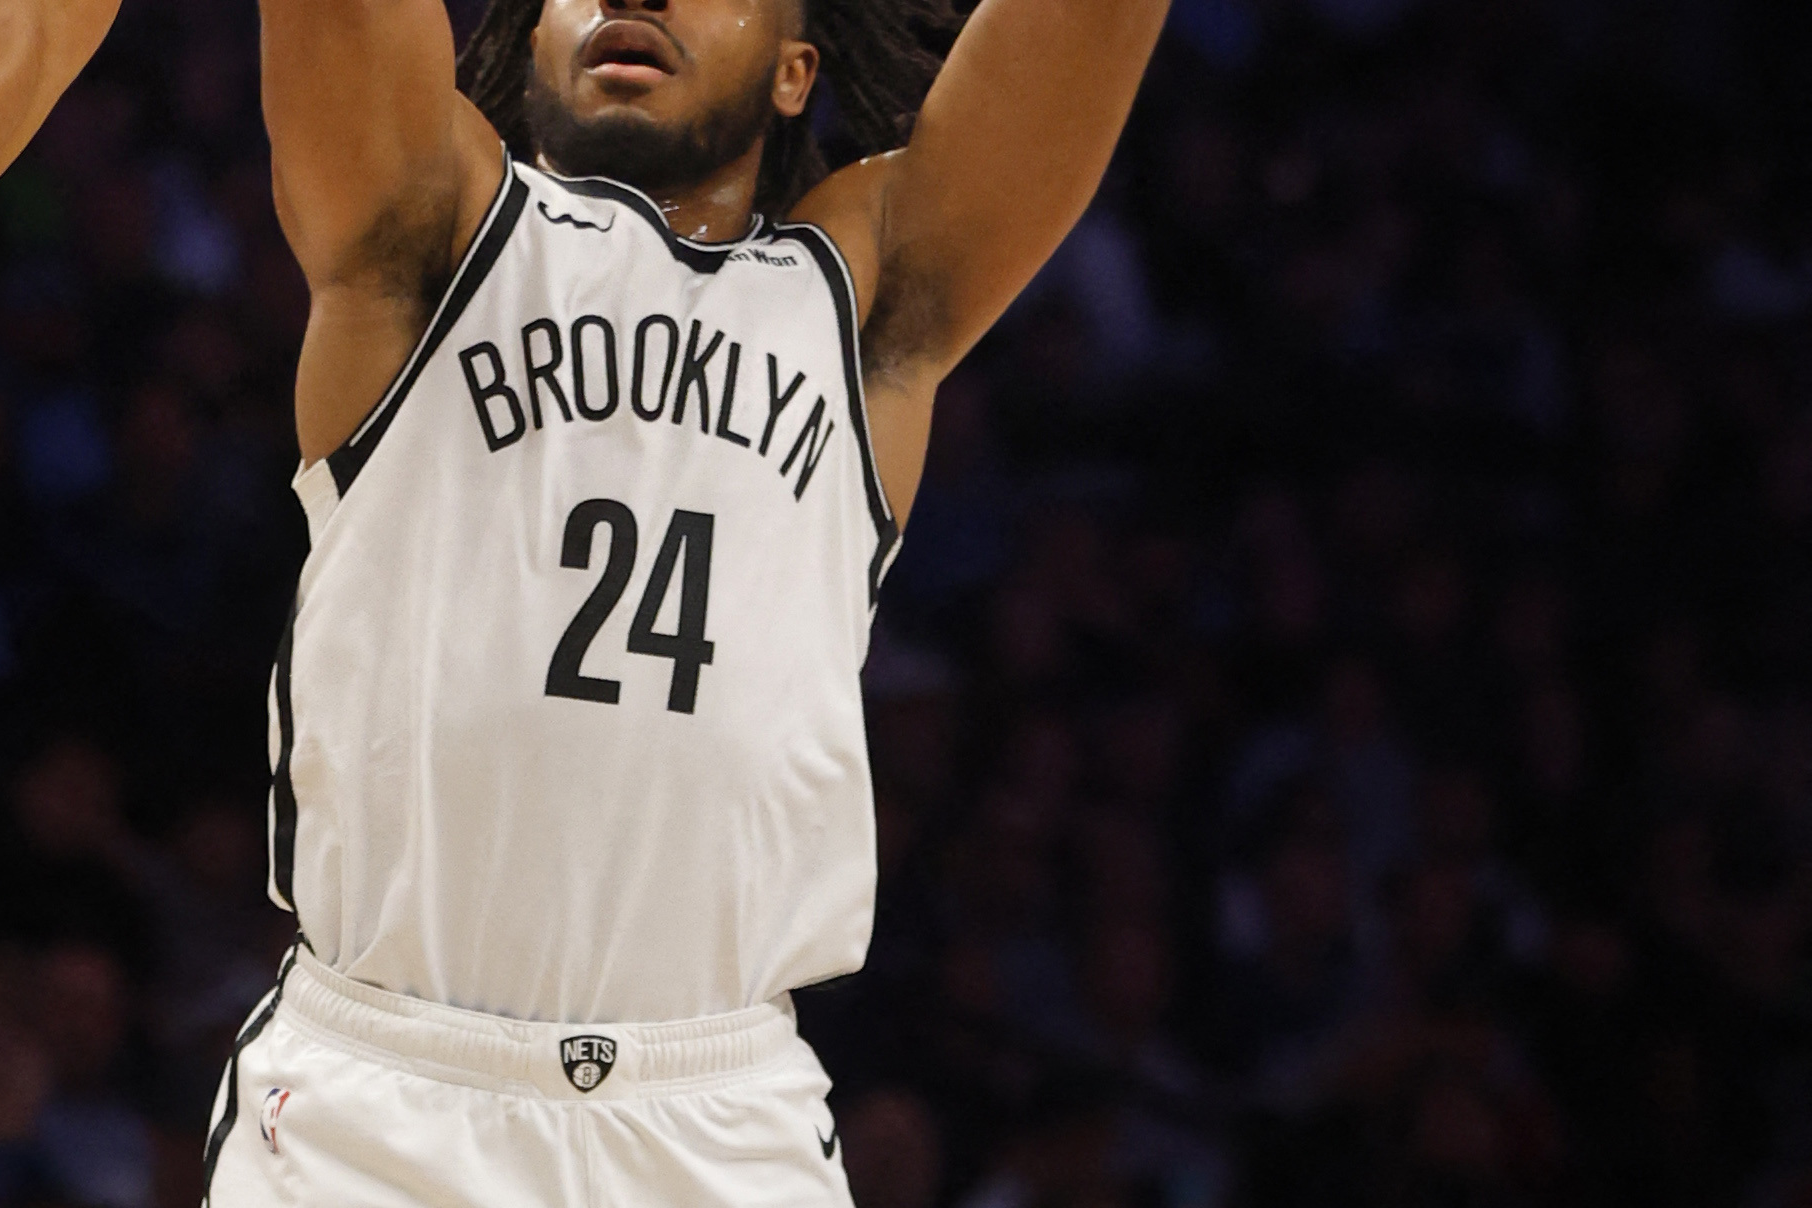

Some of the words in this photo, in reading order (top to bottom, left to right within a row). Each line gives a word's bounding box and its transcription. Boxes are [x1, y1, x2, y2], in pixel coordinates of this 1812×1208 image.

[458, 313, 835, 503] BROOKLYN
[544, 497, 716, 715] 24
[563, 1038, 614, 1064] NETS
